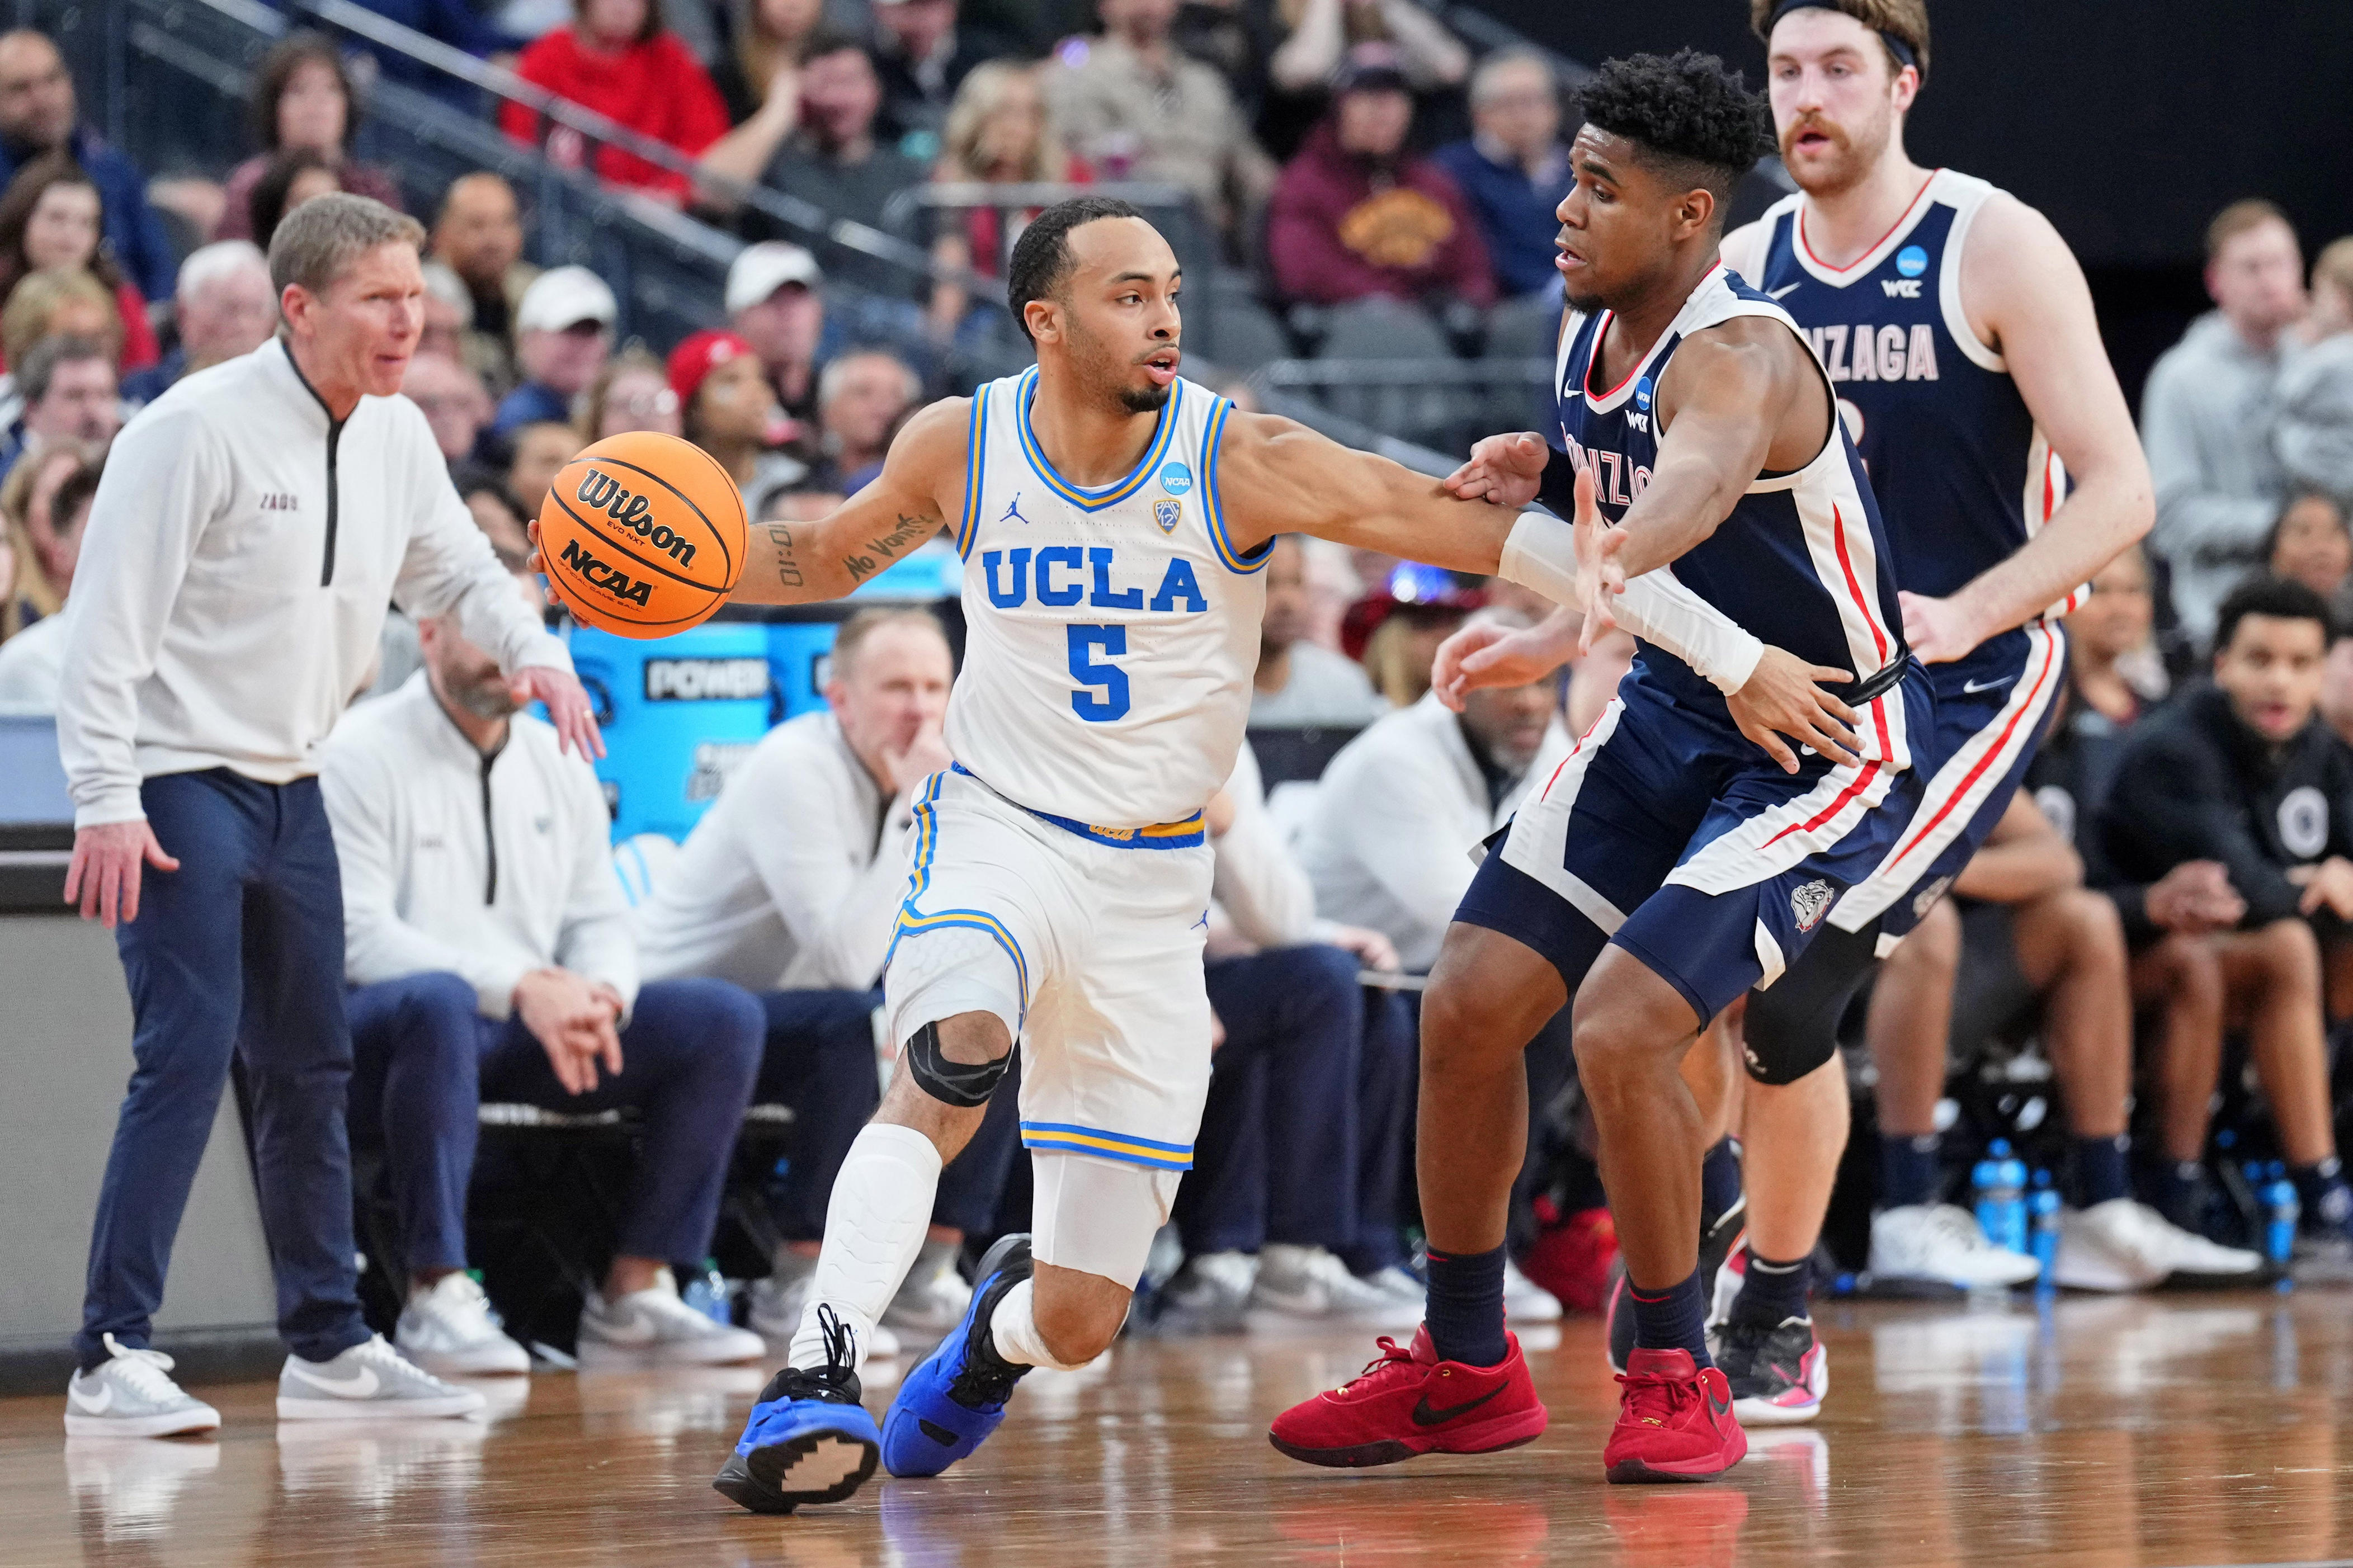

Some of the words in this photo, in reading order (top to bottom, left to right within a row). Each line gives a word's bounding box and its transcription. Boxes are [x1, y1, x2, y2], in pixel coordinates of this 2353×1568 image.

[1164, 477, 1191, 487] NCAA
[577, 467, 696, 568] Wilson
[607, 521, 625, 535] EVO
[626, 532, 646, 547] NXT
[1156, 500, 1180, 520] PAC
[1161, 513, 1175, 526] 12
[558, 559, 588, 587] OFFICIAL
[590, 586, 616, 603] GAME
[617, 600, 642, 613] BALL
[560, 538, 654, 607] NCAA
[983, 546, 1208, 613] UCLA
[1067, 624, 1130, 722] 5
